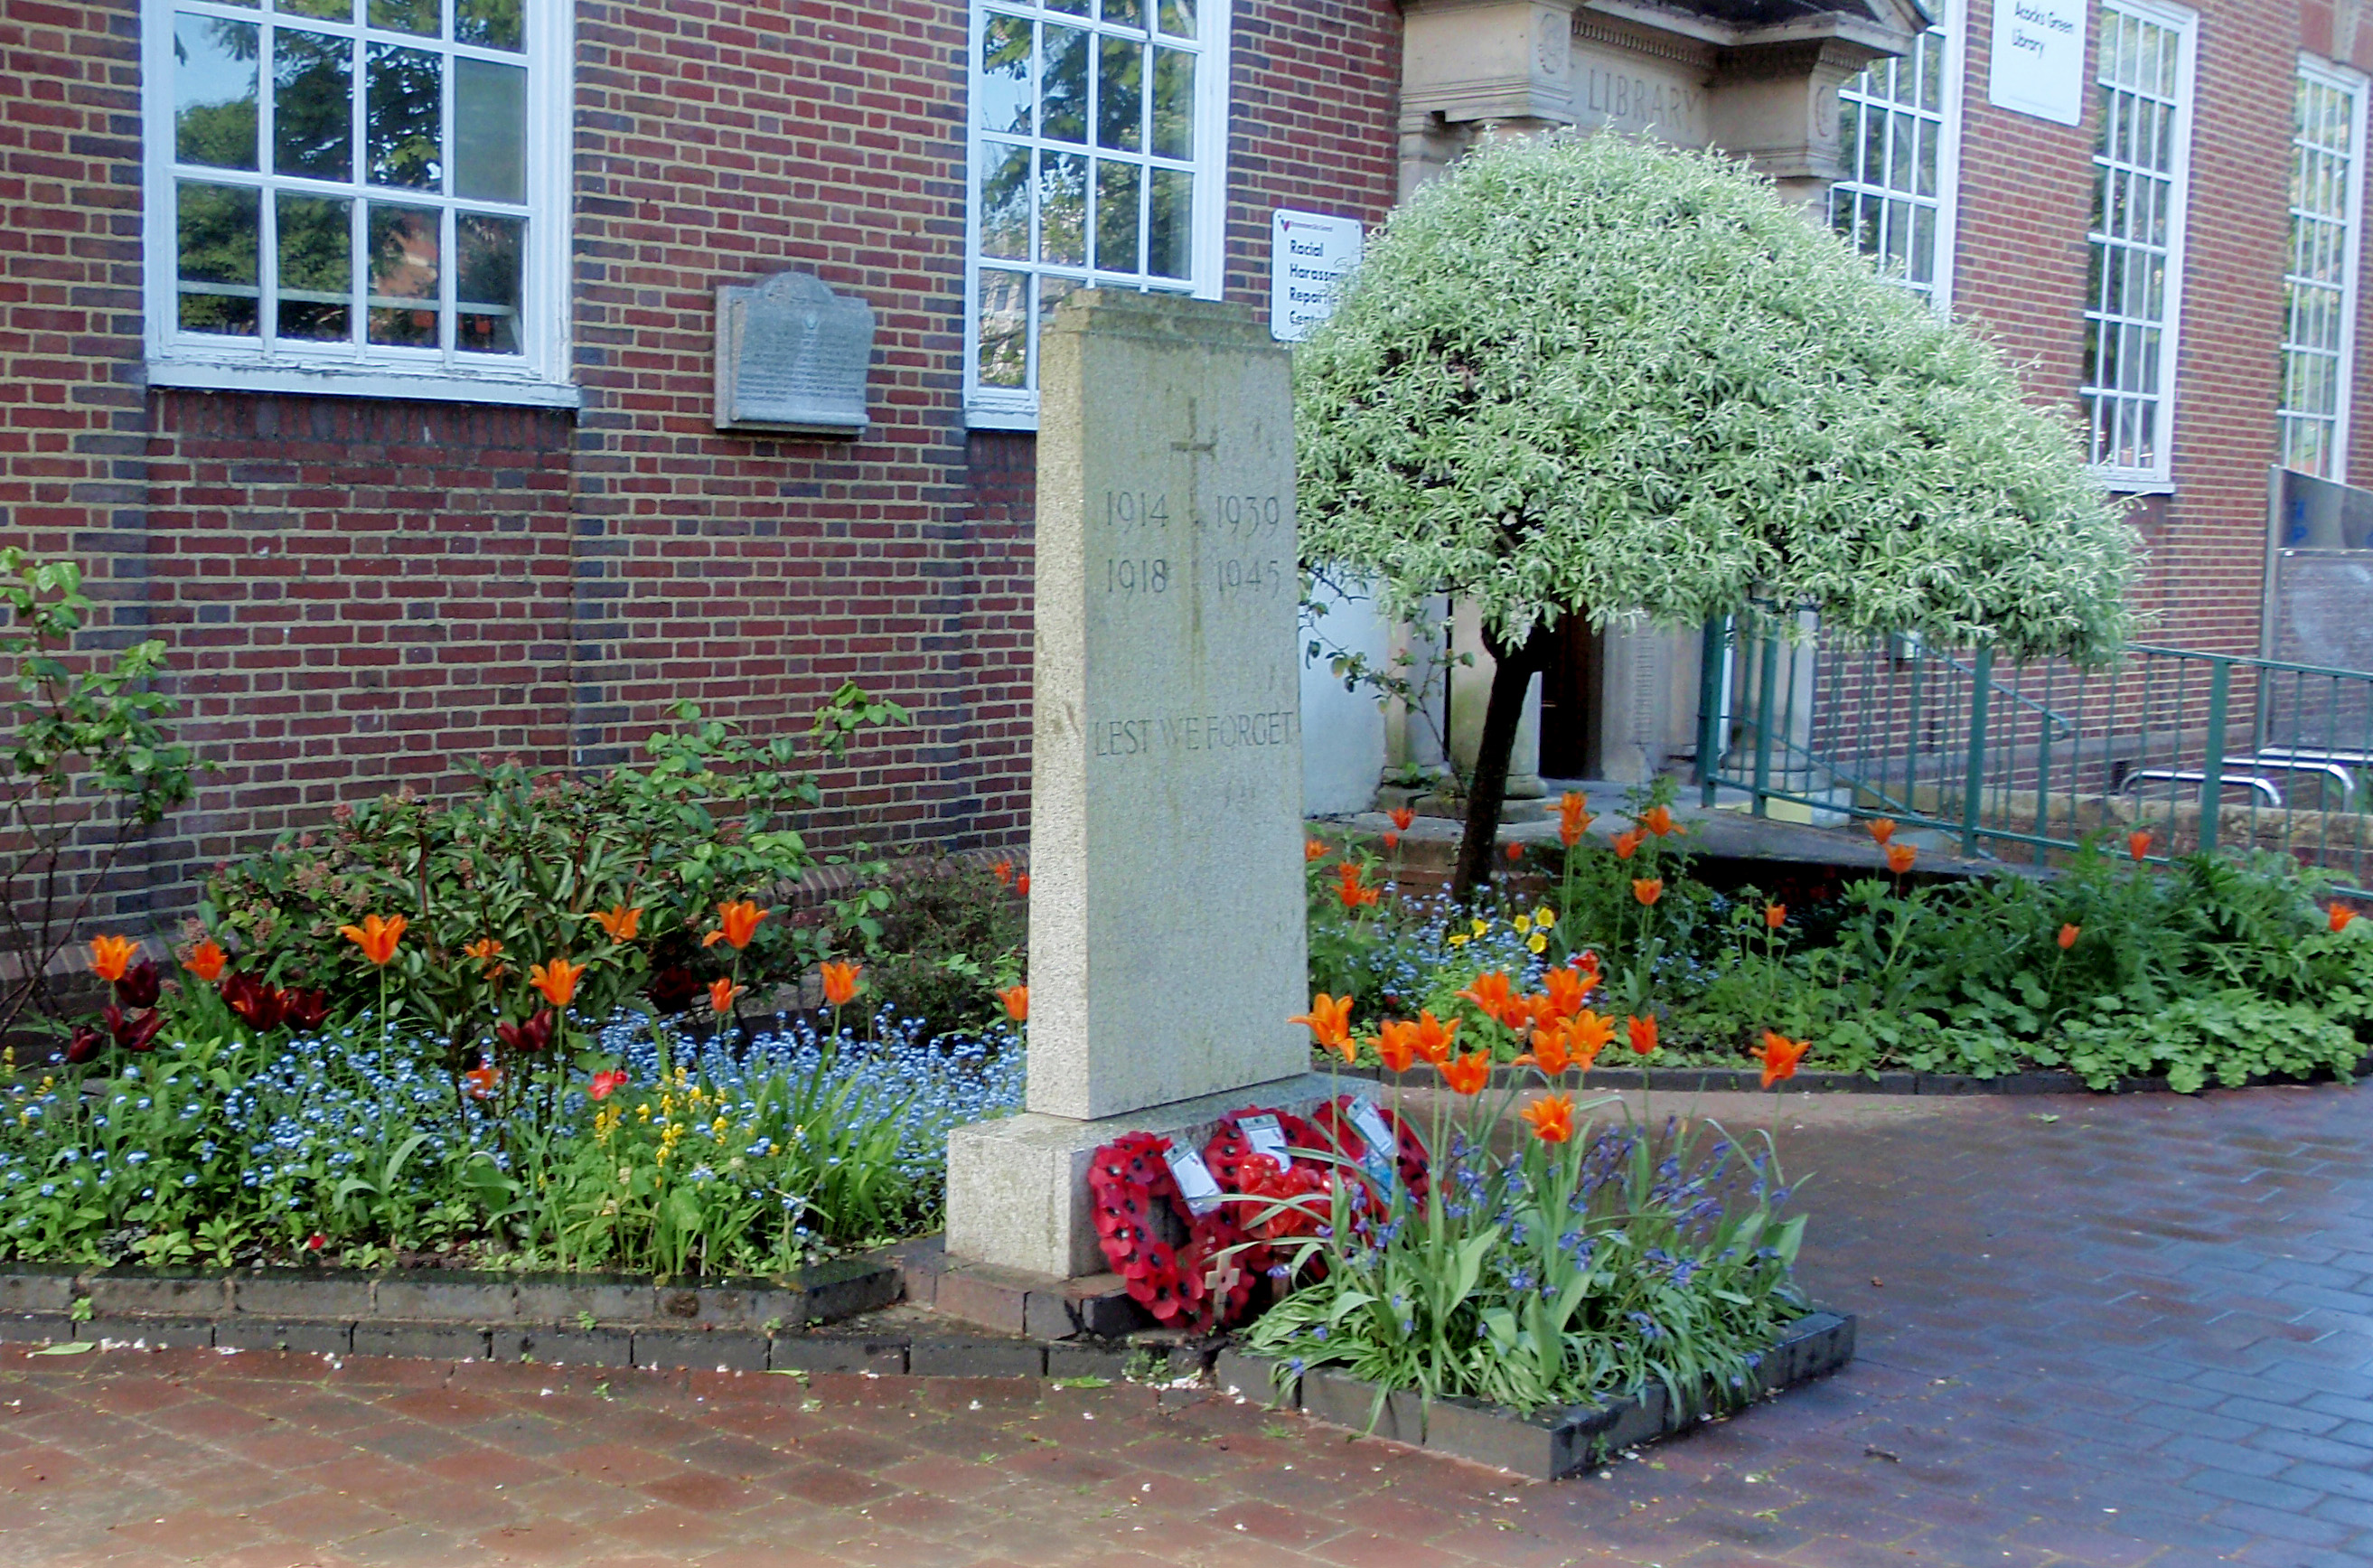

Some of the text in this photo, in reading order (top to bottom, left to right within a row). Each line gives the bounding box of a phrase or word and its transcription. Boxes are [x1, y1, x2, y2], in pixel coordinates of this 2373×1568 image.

[2012, 28, 2045, 60] Library
[1589, 68, 1700, 135] LIBRARY
[1290, 239, 1324, 258] Racial
[1108, 491, 1169, 534] 1914
[1216, 495, 1280, 539] 1939
[1108, 558, 1168, 602] 1918
[1217, 559, 1280, 601] 1945
[1094, 710, 1294, 756] LEST WE FORGET
